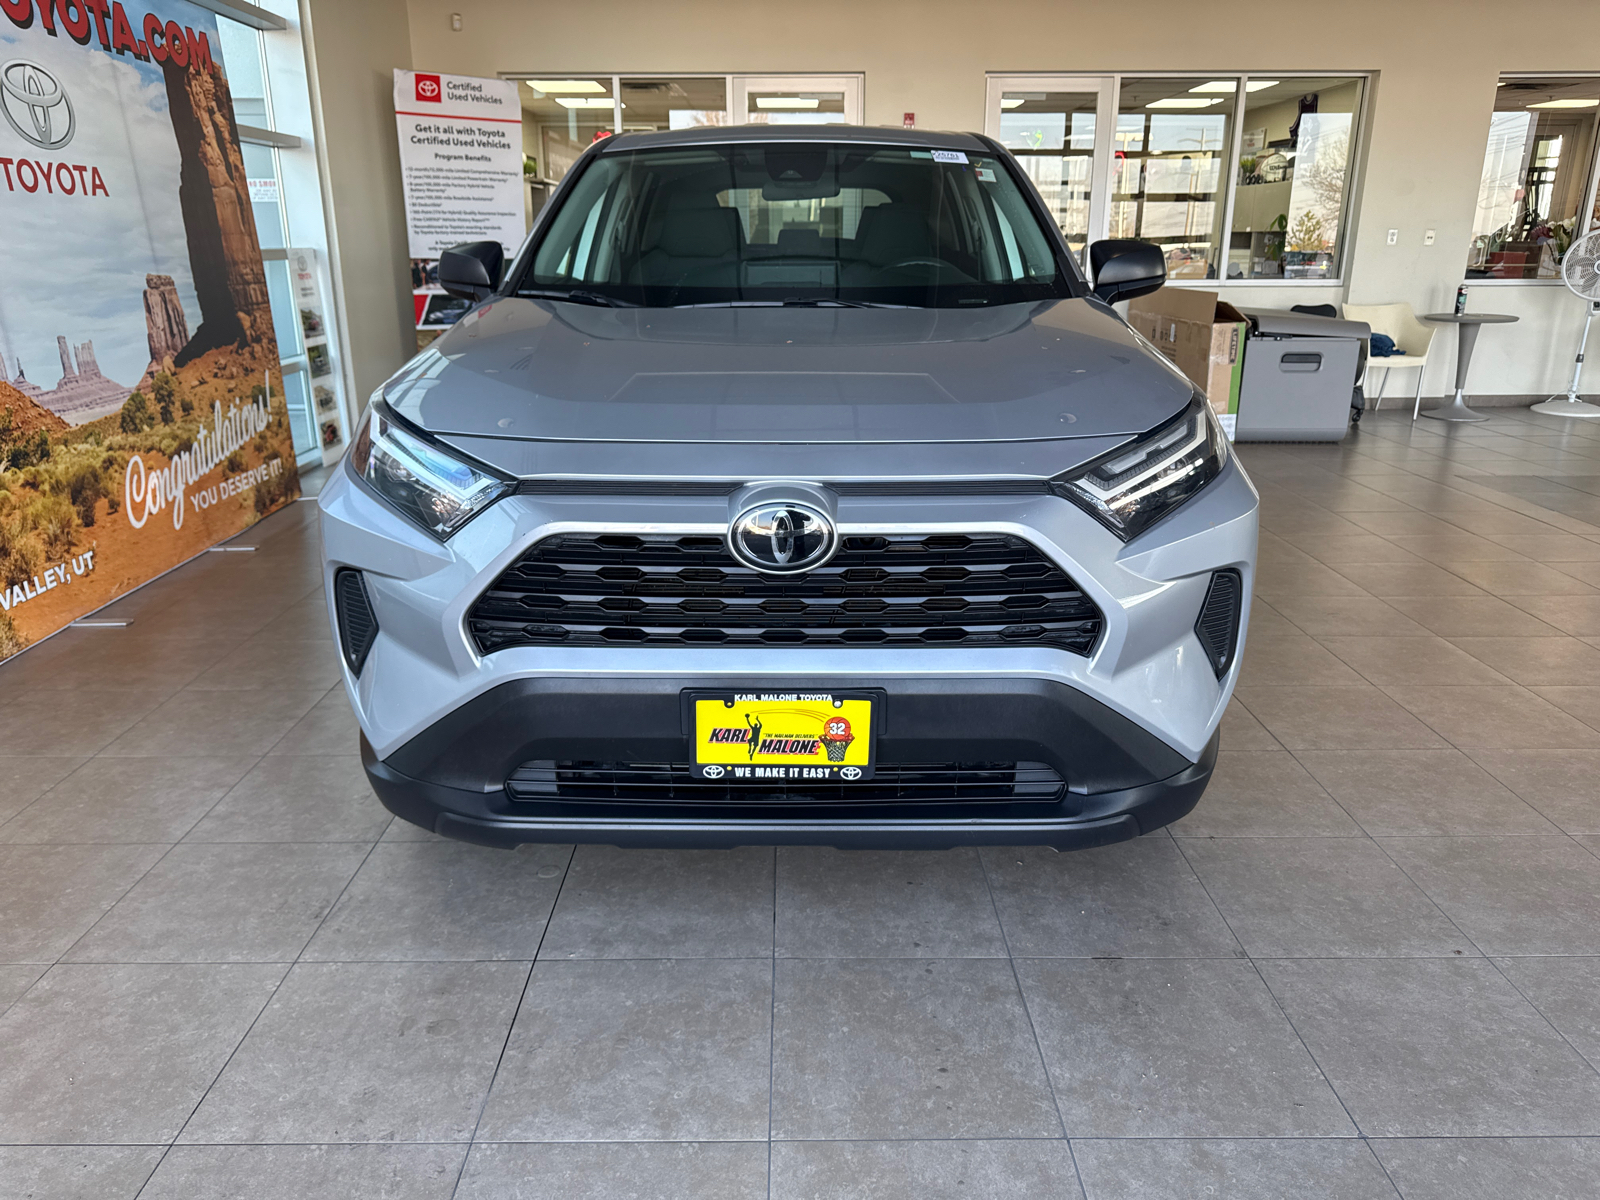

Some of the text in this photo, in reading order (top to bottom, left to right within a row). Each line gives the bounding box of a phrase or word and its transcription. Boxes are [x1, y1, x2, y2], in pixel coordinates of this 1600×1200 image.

[446, 81, 482, 92] Certified
[447, 92, 503, 104] Used Vehicles
[415, 124, 505, 139] Get it all with Toyota
[410, 135, 511, 149] Certified Used Vehicles
[434, 152, 492, 162] Program Benefits
[0, 157, 109, 197] TOYOTA
[125, 369, 273, 530] Congratulations!
[190, 458, 284, 512] YOU DESERVE IT!
[0, 550, 94, 611] VALLEY, UT
[734, 694, 833, 702] KARL MALONE TOYOTA
[829, 722, 846, 735] 32
[708, 728, 750, 744] KARL
[757, 739, 821, 755] MALONE
[734, 767, 831, 778] WE MAKE IT EASY
